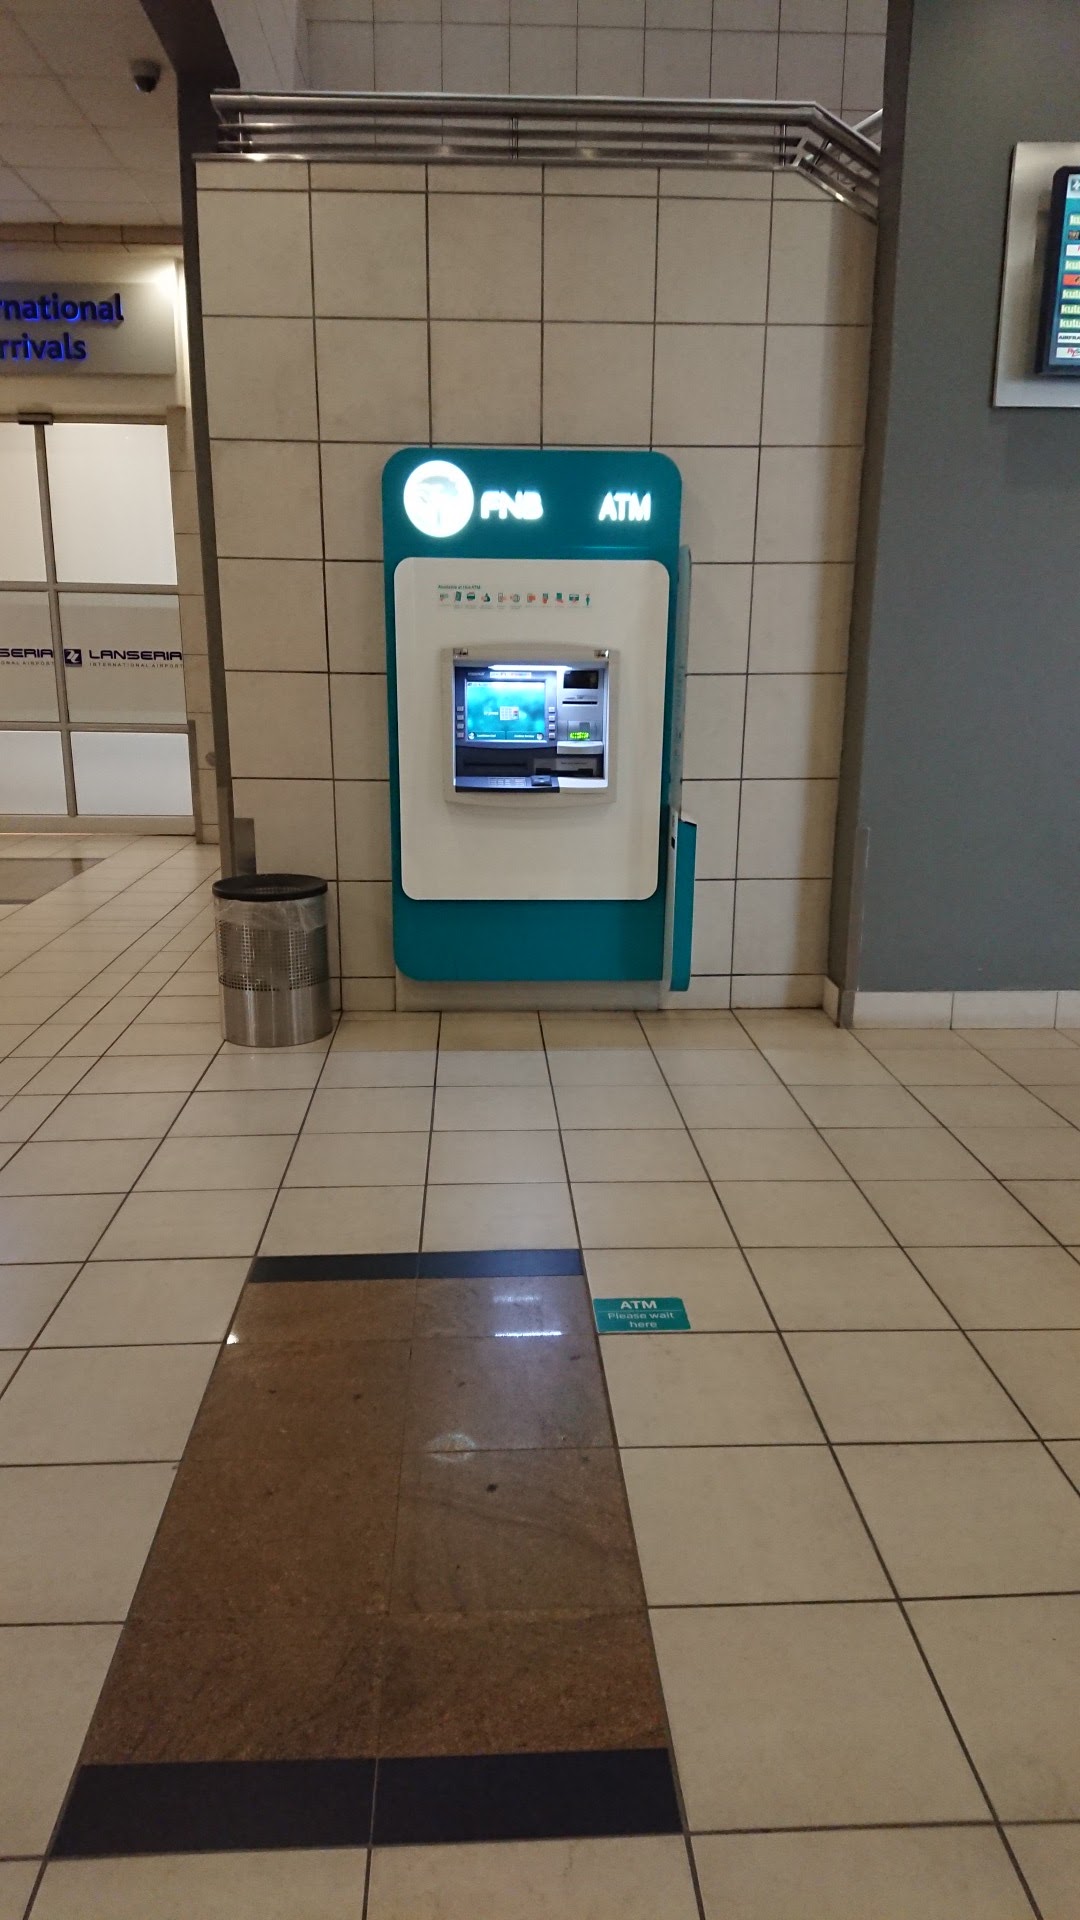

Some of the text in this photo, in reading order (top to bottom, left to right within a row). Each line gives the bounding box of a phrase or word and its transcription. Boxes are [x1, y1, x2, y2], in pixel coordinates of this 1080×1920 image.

[480, 491, 652, 521] FNB ATM
[89, 650, 183, 660] LANSERIA
[620, 1300, 657, 1309] ATM
